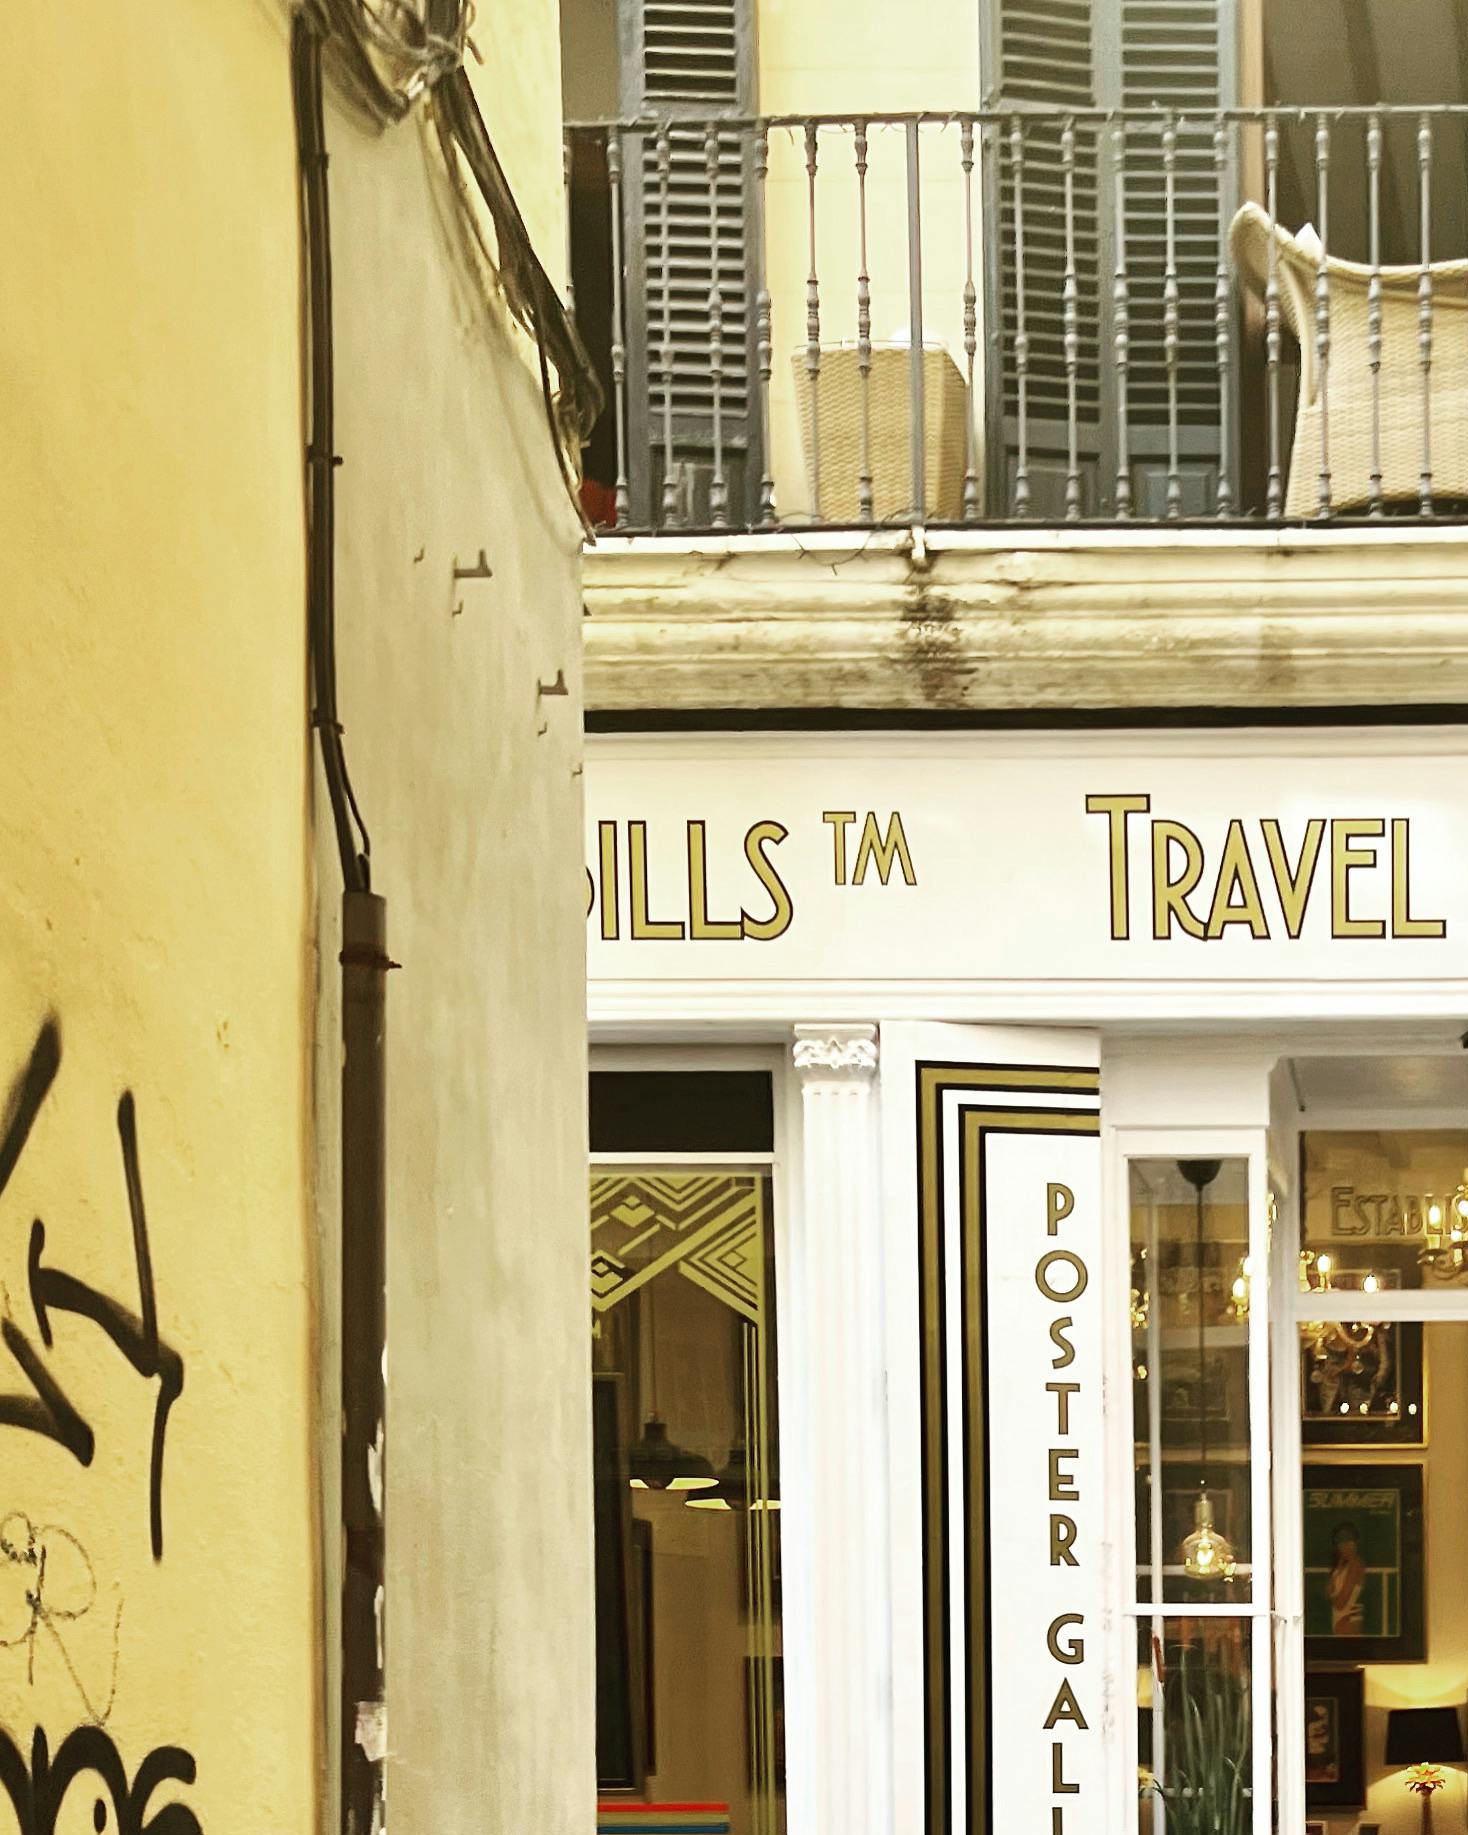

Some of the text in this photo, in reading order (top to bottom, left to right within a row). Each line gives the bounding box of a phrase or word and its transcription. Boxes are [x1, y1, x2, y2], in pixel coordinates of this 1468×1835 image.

[586, 810, 918, 942] ILLS TM
[1085, 793, 1447, 942] TRAVEL
[1034, 1182, 1089, 1567] POSTER
